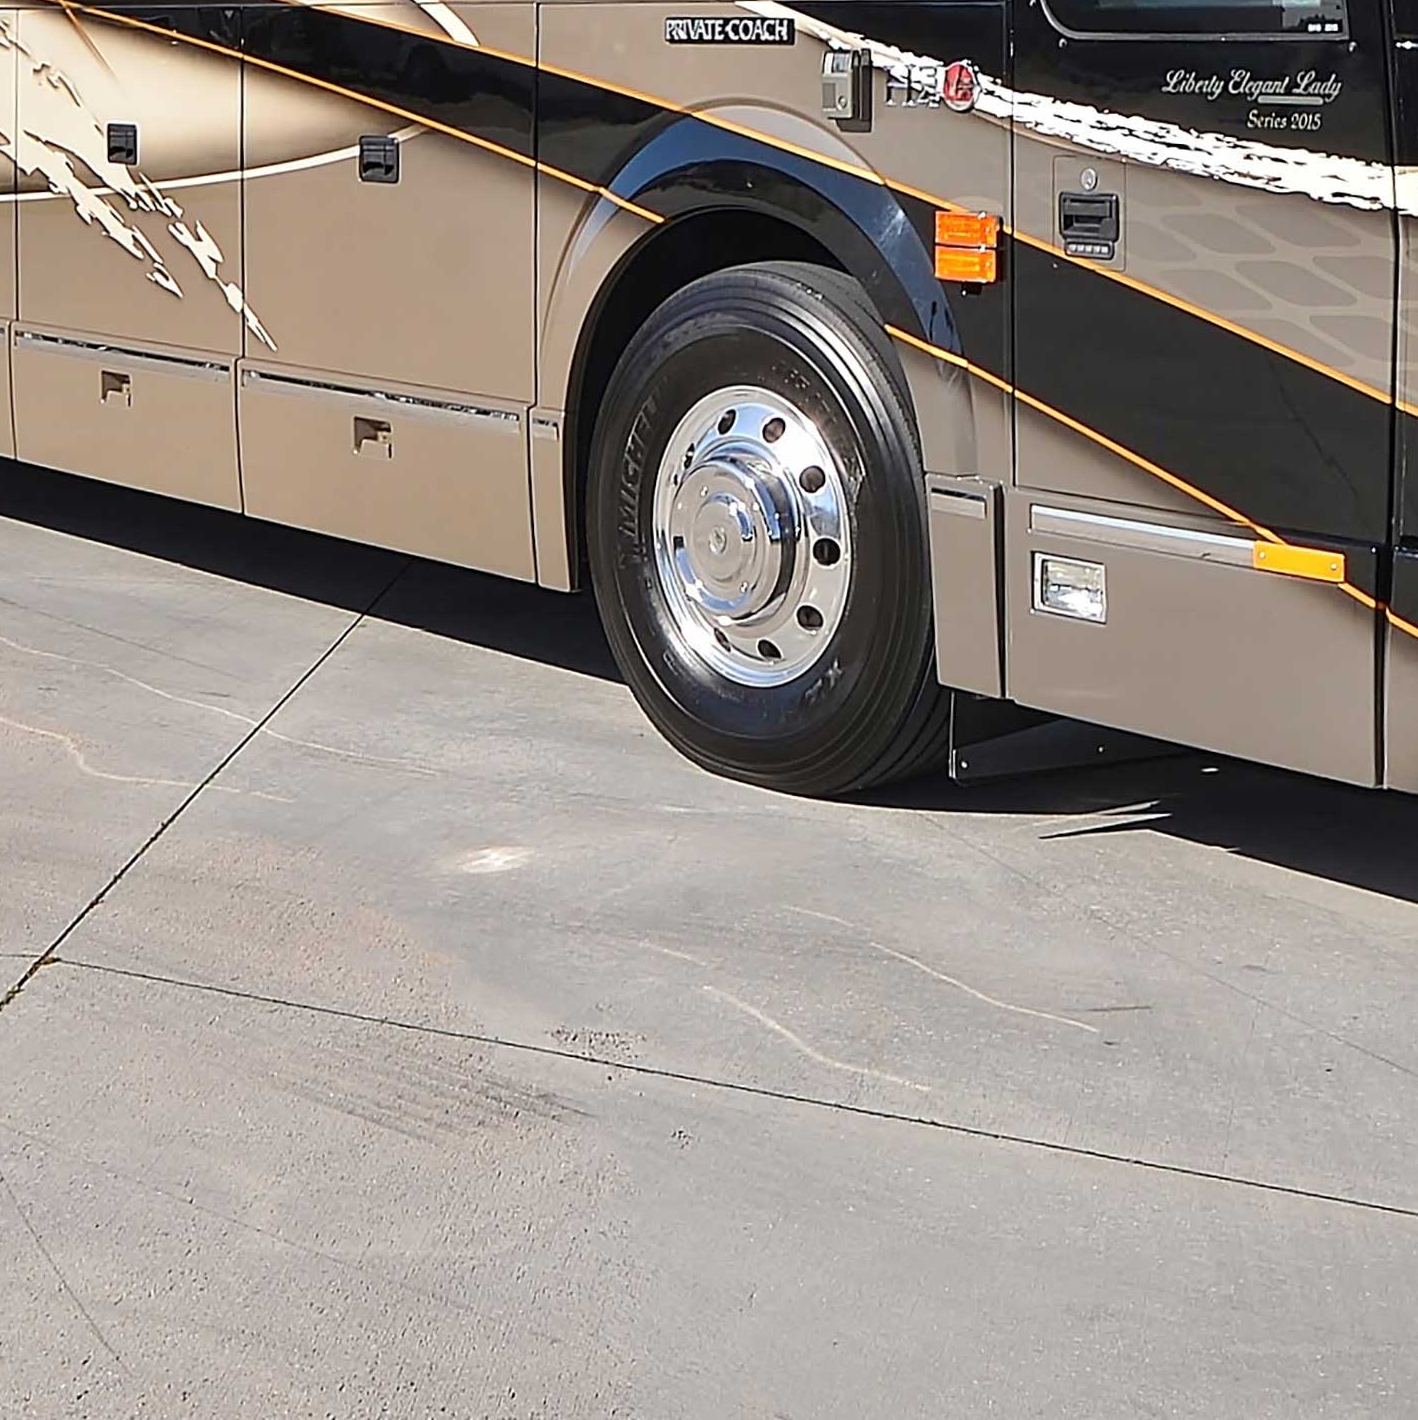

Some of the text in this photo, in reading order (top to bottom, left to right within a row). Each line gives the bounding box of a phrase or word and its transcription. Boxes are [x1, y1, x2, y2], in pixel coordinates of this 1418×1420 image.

[666, 19, 789, 42] PRIVATE COACH
[1161, 69, 1342, 103] Liberty Elegant Lady
[1247, 109, 1322, 131] Series 2015
